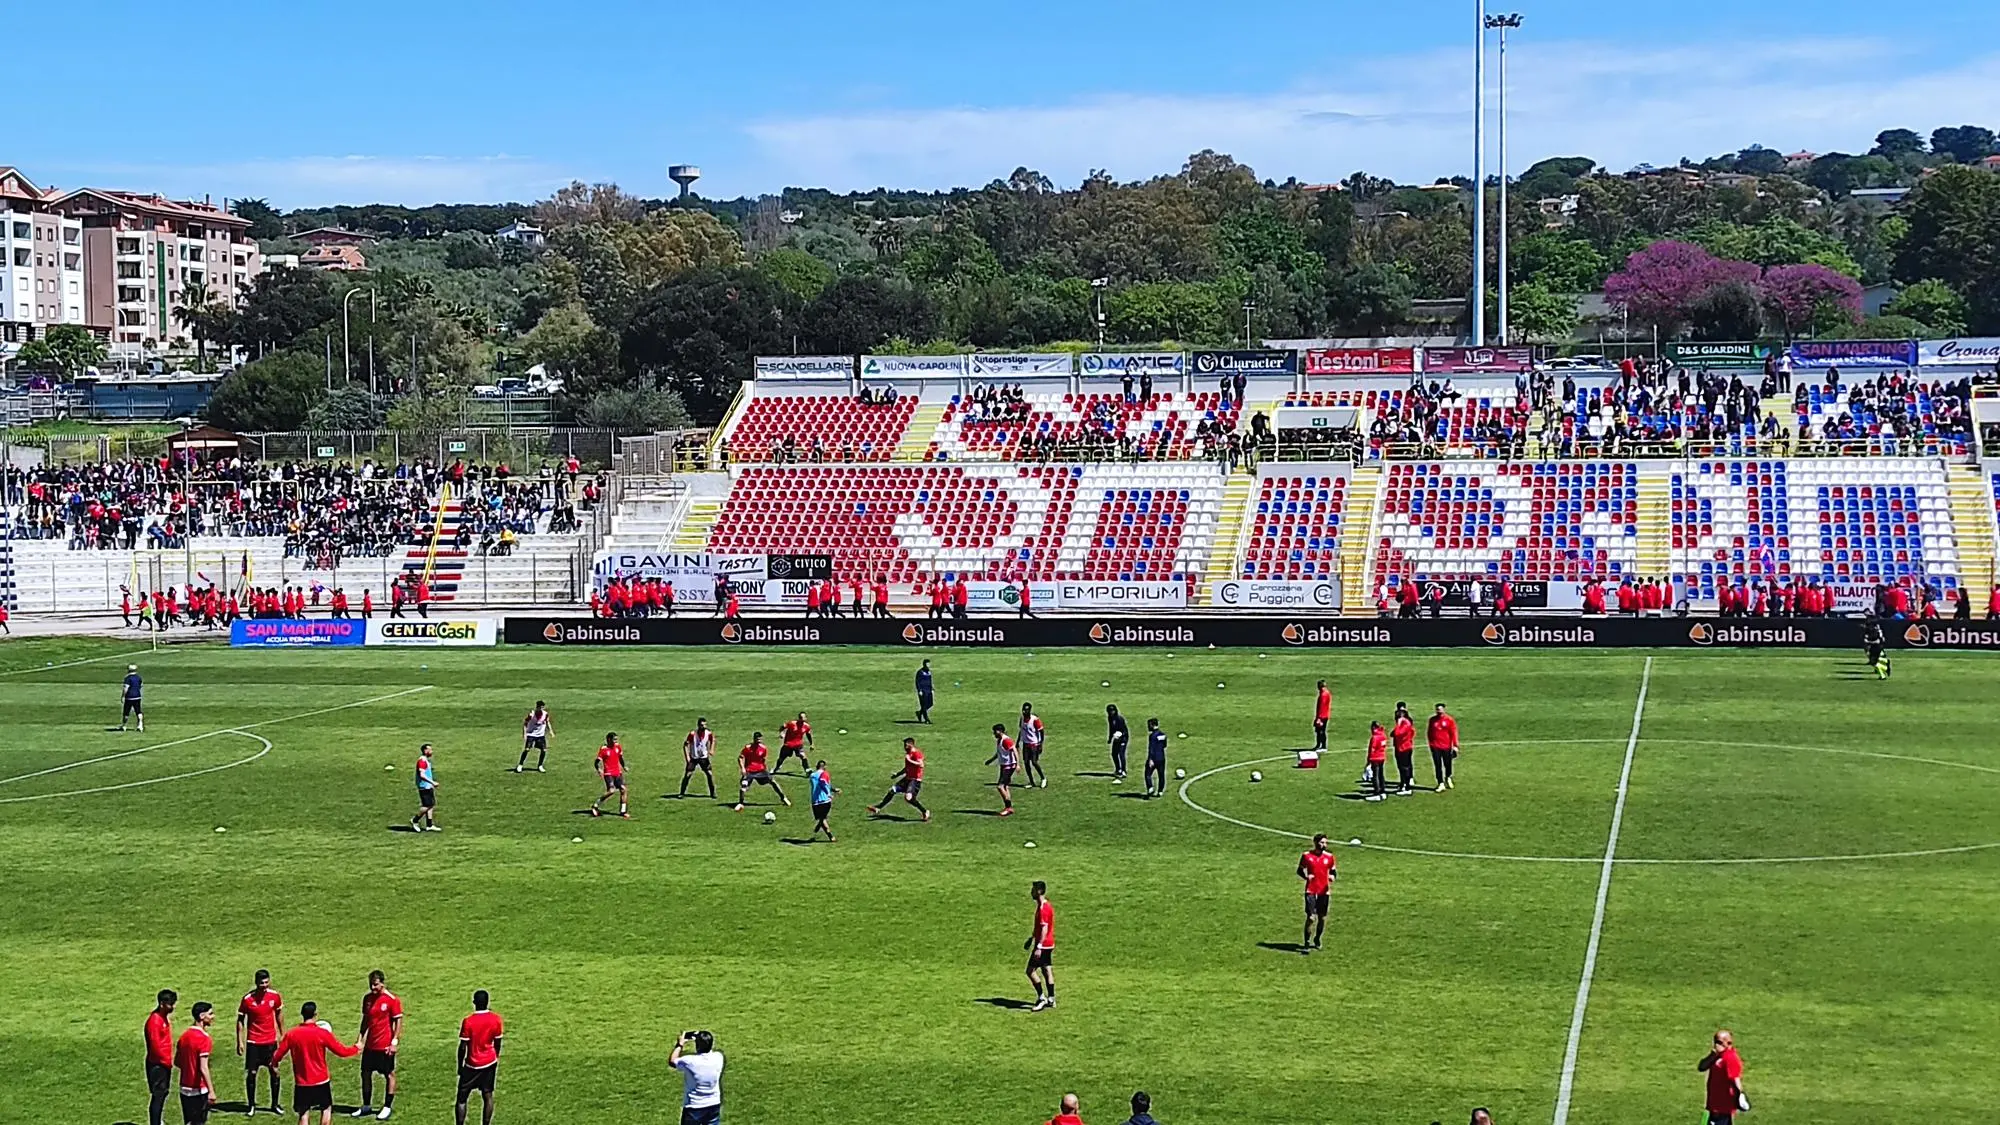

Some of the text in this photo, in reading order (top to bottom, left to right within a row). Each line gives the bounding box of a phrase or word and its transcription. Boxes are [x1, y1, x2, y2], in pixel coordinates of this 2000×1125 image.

[1677, 345, 1750, 355] D&S GIARDINI
[1800, 344, 1832, 355] SAN
[769, 362, 844, 371] SCANDELLARI
[884, 362, 916, 370] NUOVA
[1108, 357, 1184, 369] MATICA
[1220, 356, 1284, 369] Character
[1310, 352, 1379, 370] Testoni
[620, 554, 710, 568] GAVINI
[716, 557, 754, 570] TASTY
[795, 558, 826, 568] CIVICO
[731, 581, 766, 594] RONY
[781, 581, 812, 594] TRON
[1063, 586, 1180, 599] EMPORIUM
[1249, 593, 1304, 604] Puggioni
[245, 623, 353, 635] SAN MARTINO
[566, 625, 641, 640] abinsula
[744, 625, 820, 640] abinsula
[926, 625, 1004, 641] abinsula
[1113, 625, 1194, 641] abinsula
[1307, 625, 1391, 641] abinsula
[1508, 625, 1595, 641] abinsula
[1716, 626, 1806, 643] abinsula
